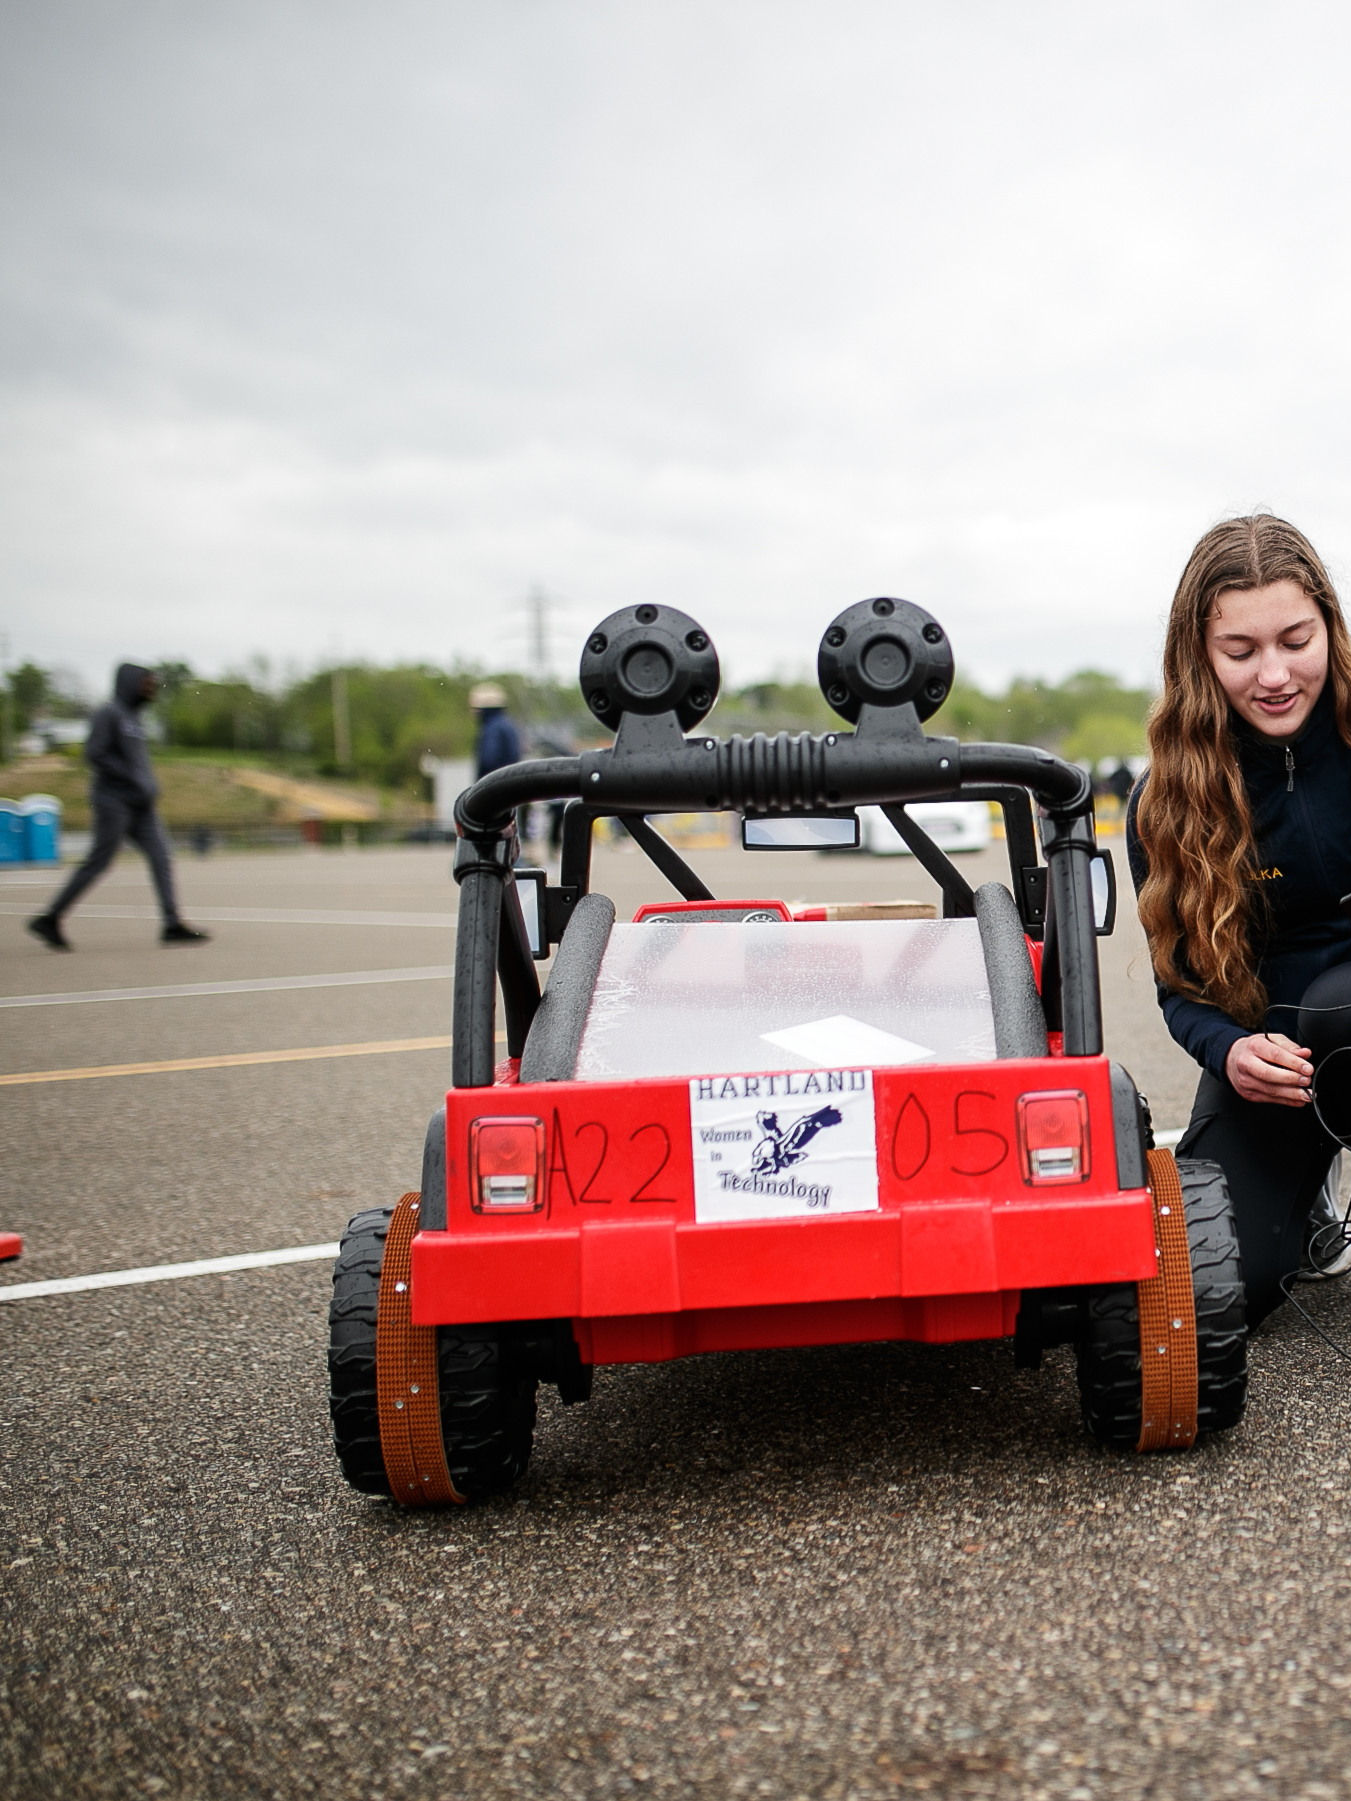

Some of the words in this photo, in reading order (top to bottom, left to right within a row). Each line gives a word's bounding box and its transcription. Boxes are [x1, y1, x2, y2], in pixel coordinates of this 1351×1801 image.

[697, 1071, 865, 1099] HARTLAND
[701, 1128, 752, 1143] Women
[547, 1107, 677, 1220] A22
[711, 1150, 723, 1162] in
[718, 1171, 832, 1207] Technology
